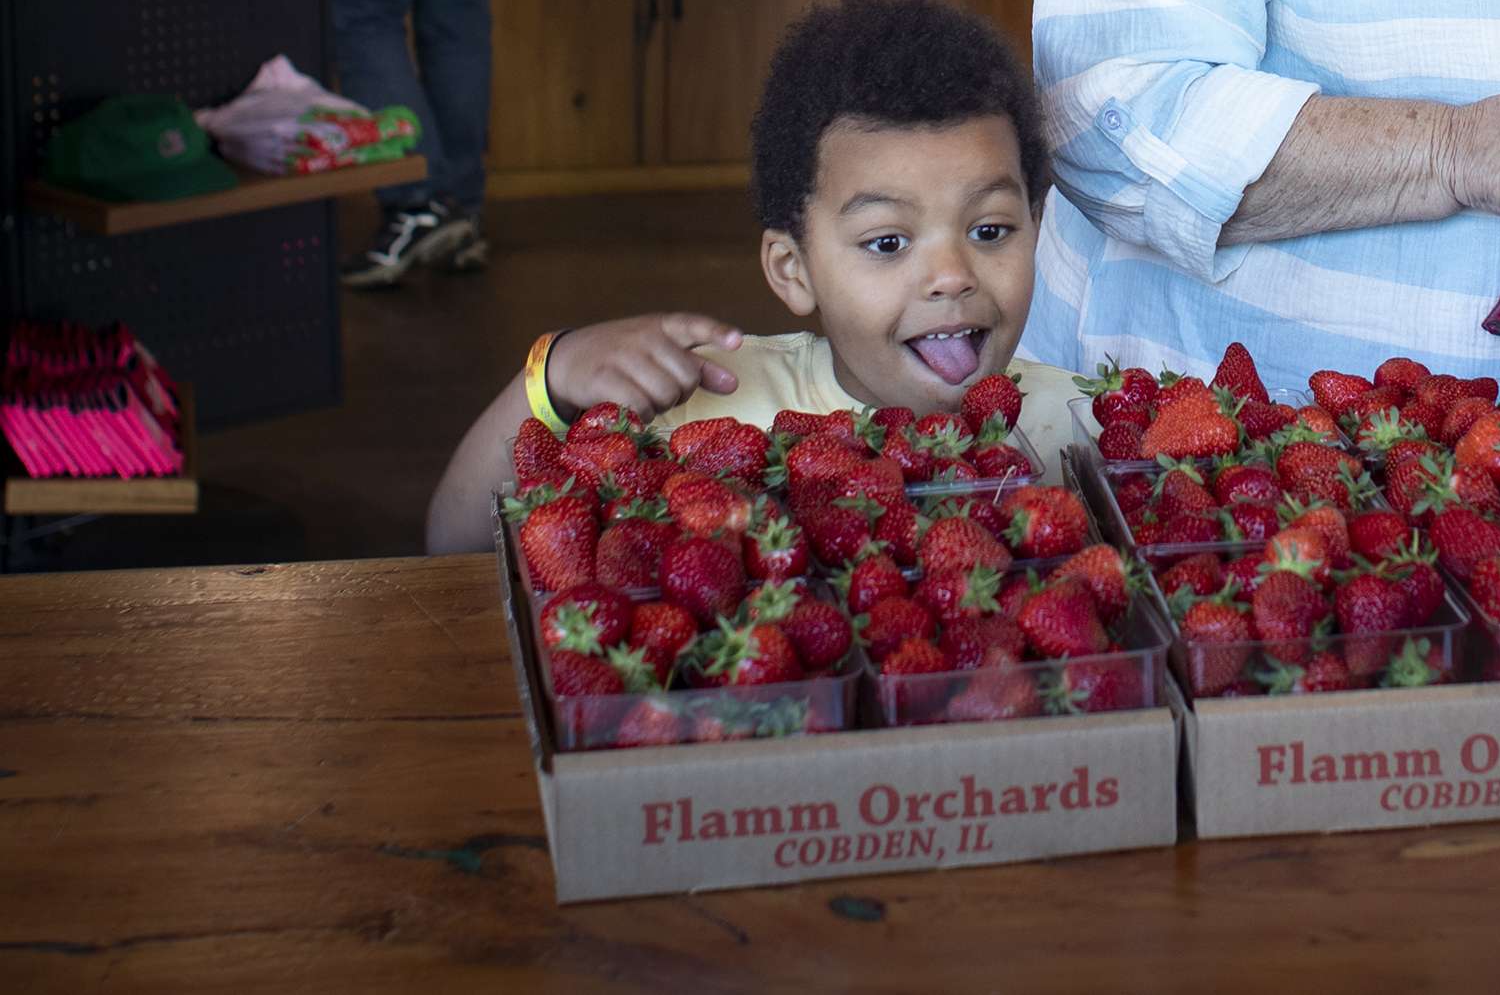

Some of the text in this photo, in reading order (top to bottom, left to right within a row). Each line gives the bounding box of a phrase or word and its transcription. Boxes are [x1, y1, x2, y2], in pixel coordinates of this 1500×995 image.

[1257, 741, 1443, 786] Flamm
[642, 766, 1119, 845] Flamm Orchards
[774, 823, 994, 870] COBDEN, IL
